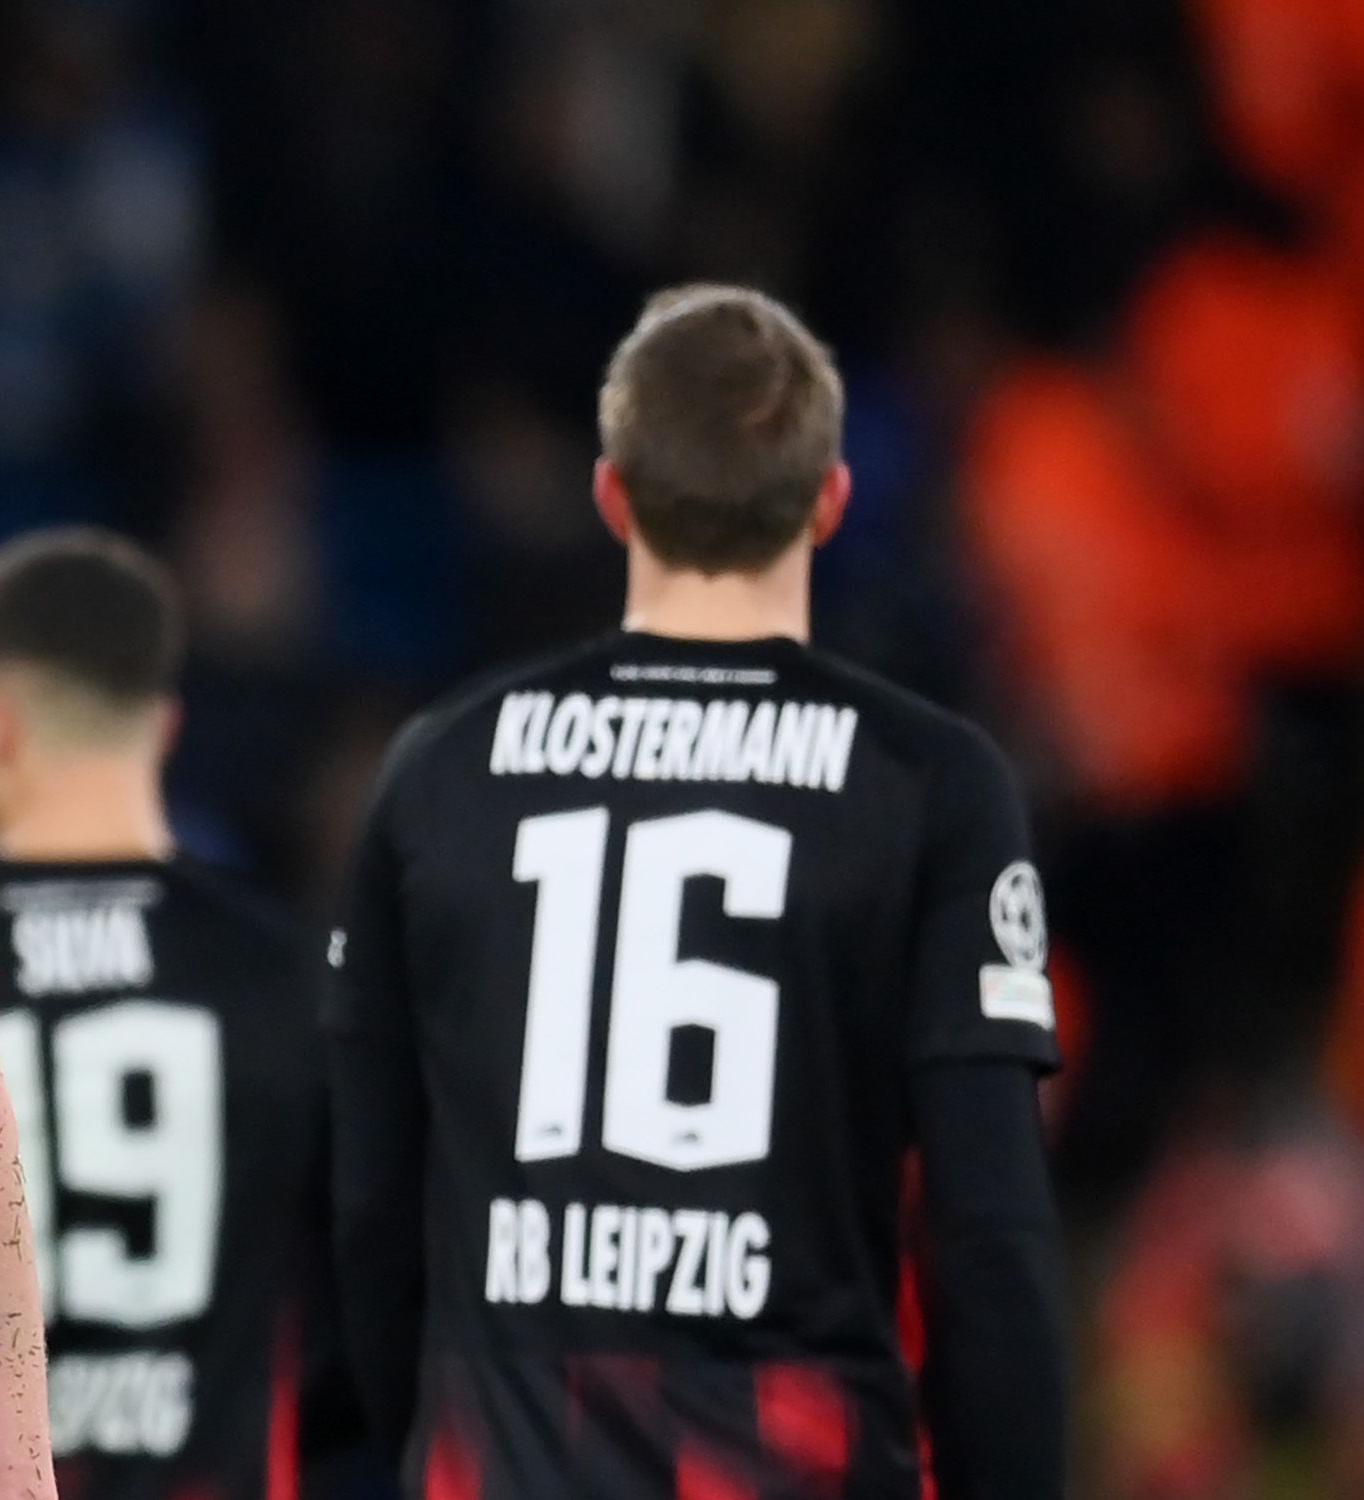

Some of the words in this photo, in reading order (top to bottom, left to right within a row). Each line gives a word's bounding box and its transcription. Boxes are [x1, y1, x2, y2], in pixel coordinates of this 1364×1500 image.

[490, 692, 858, 793] KLOSTERMANN
[513, 806, 792, 1172] 16
[485, 1199, 550, 1303] RB
[561, 1203, 771, 1319] LEIPZIG
